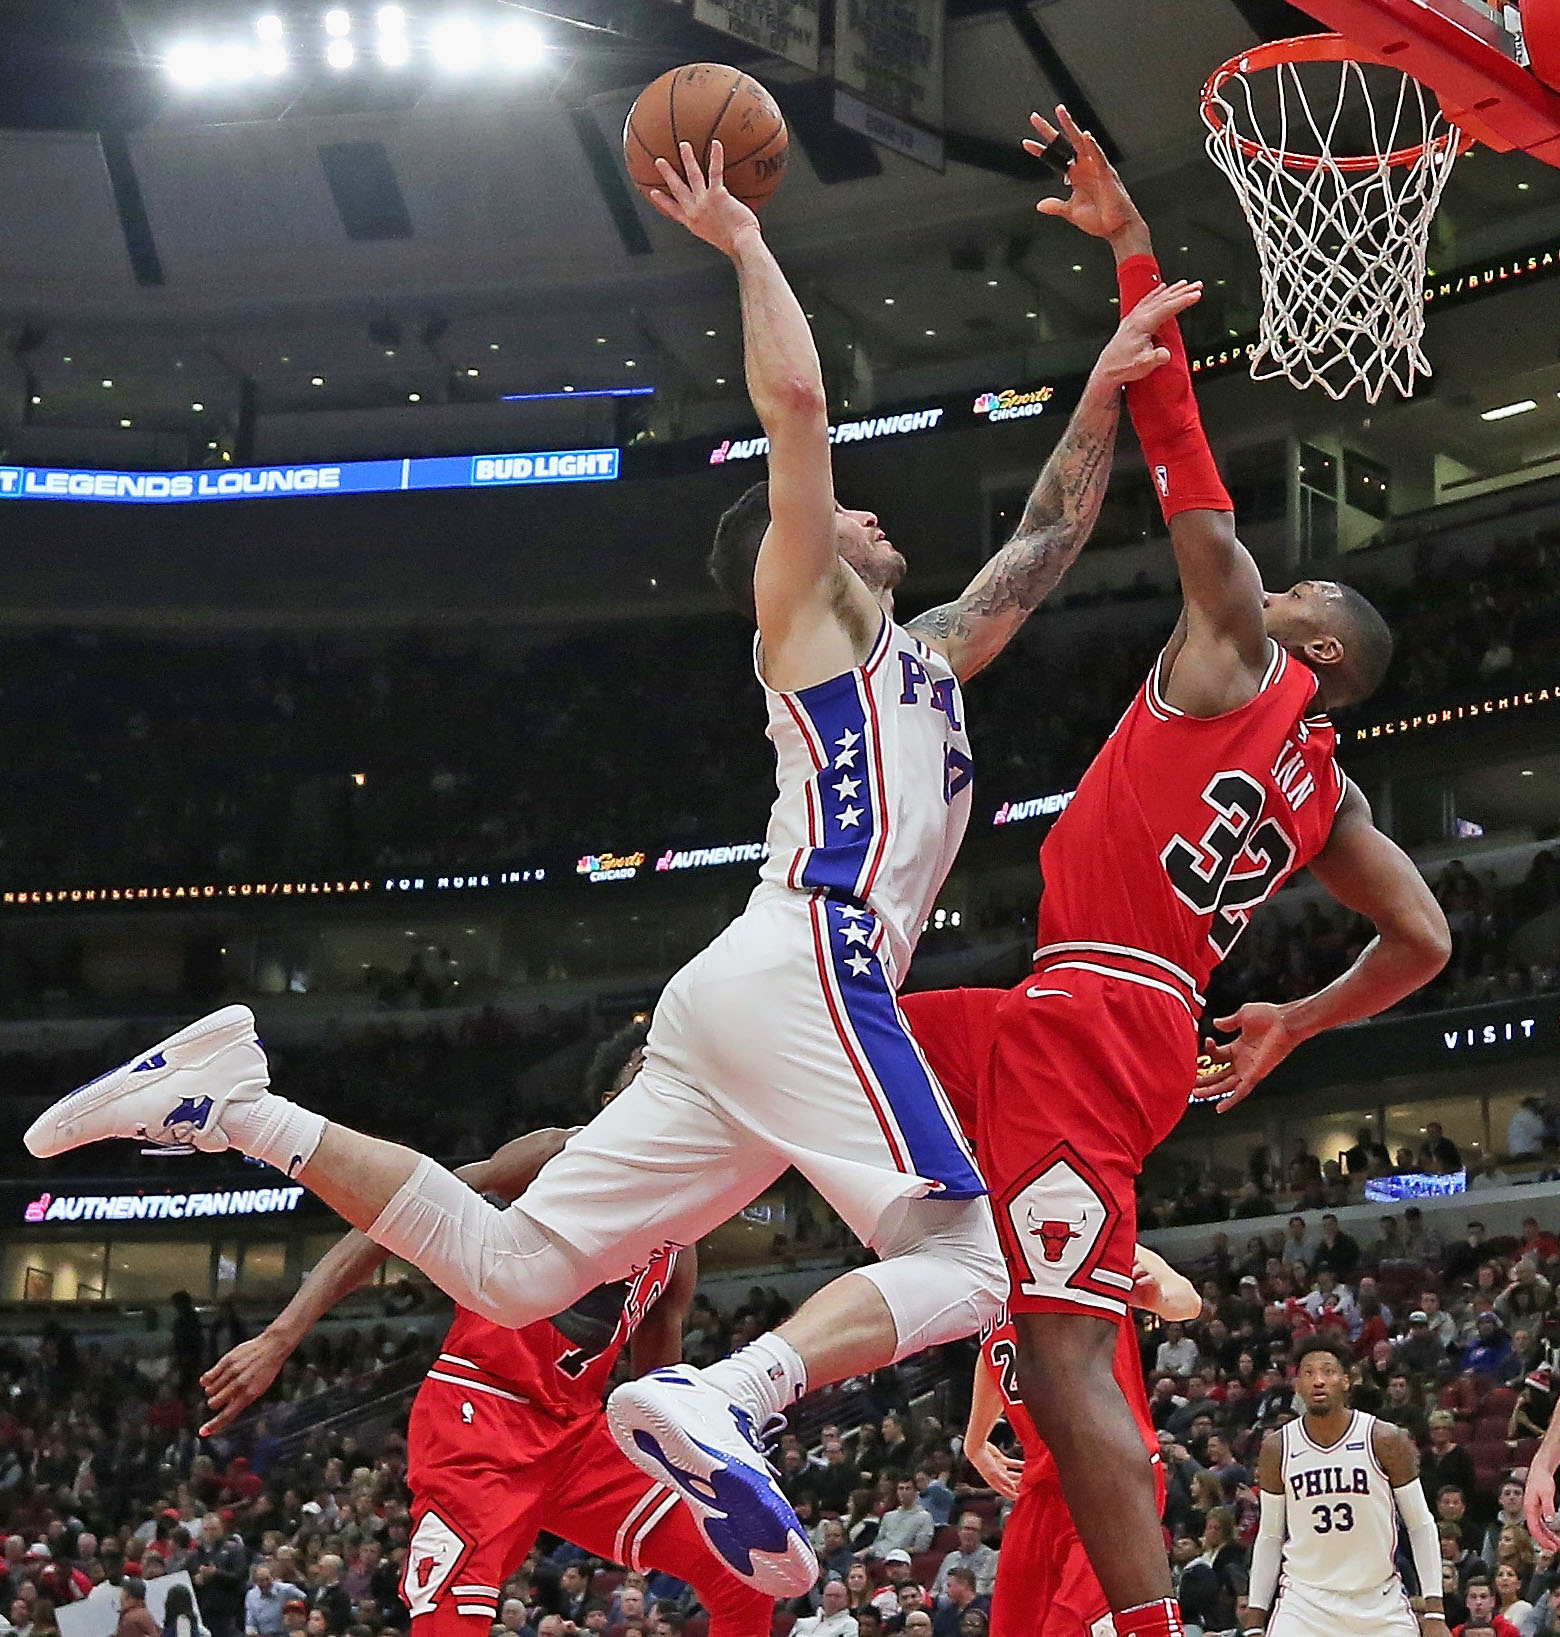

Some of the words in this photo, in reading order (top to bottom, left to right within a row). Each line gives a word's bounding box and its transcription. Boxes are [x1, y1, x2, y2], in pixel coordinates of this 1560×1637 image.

[988, 402, 1043, 422] CHICAGO
[998, 386, 1054, 408] Sports
[835, 419, 877, 444] FAN
[874, 408, 944, 436] NIGHT
[25, 471, 194, 498] LEGENDS
[198, 467, 341, 495] LOUNGE
[476, 457, 533, 481] BUD
[534, 453, 614, 478] LIGHT
[669, 842, 762, 870] AUTHENTIC
[1159, 769, 1298, 961] 32
[1444, 1018, 1536, 1050] VISIT
[45, 1194, 186, 1221] AUTHENTIC
[184, 1190, 231, 1218] FAN
[228, 1186, 305, 1214] NIGHT
[1290, 1466, 1371, 1501] PHILA
[1311, 1502, 1355, 1534] 33
